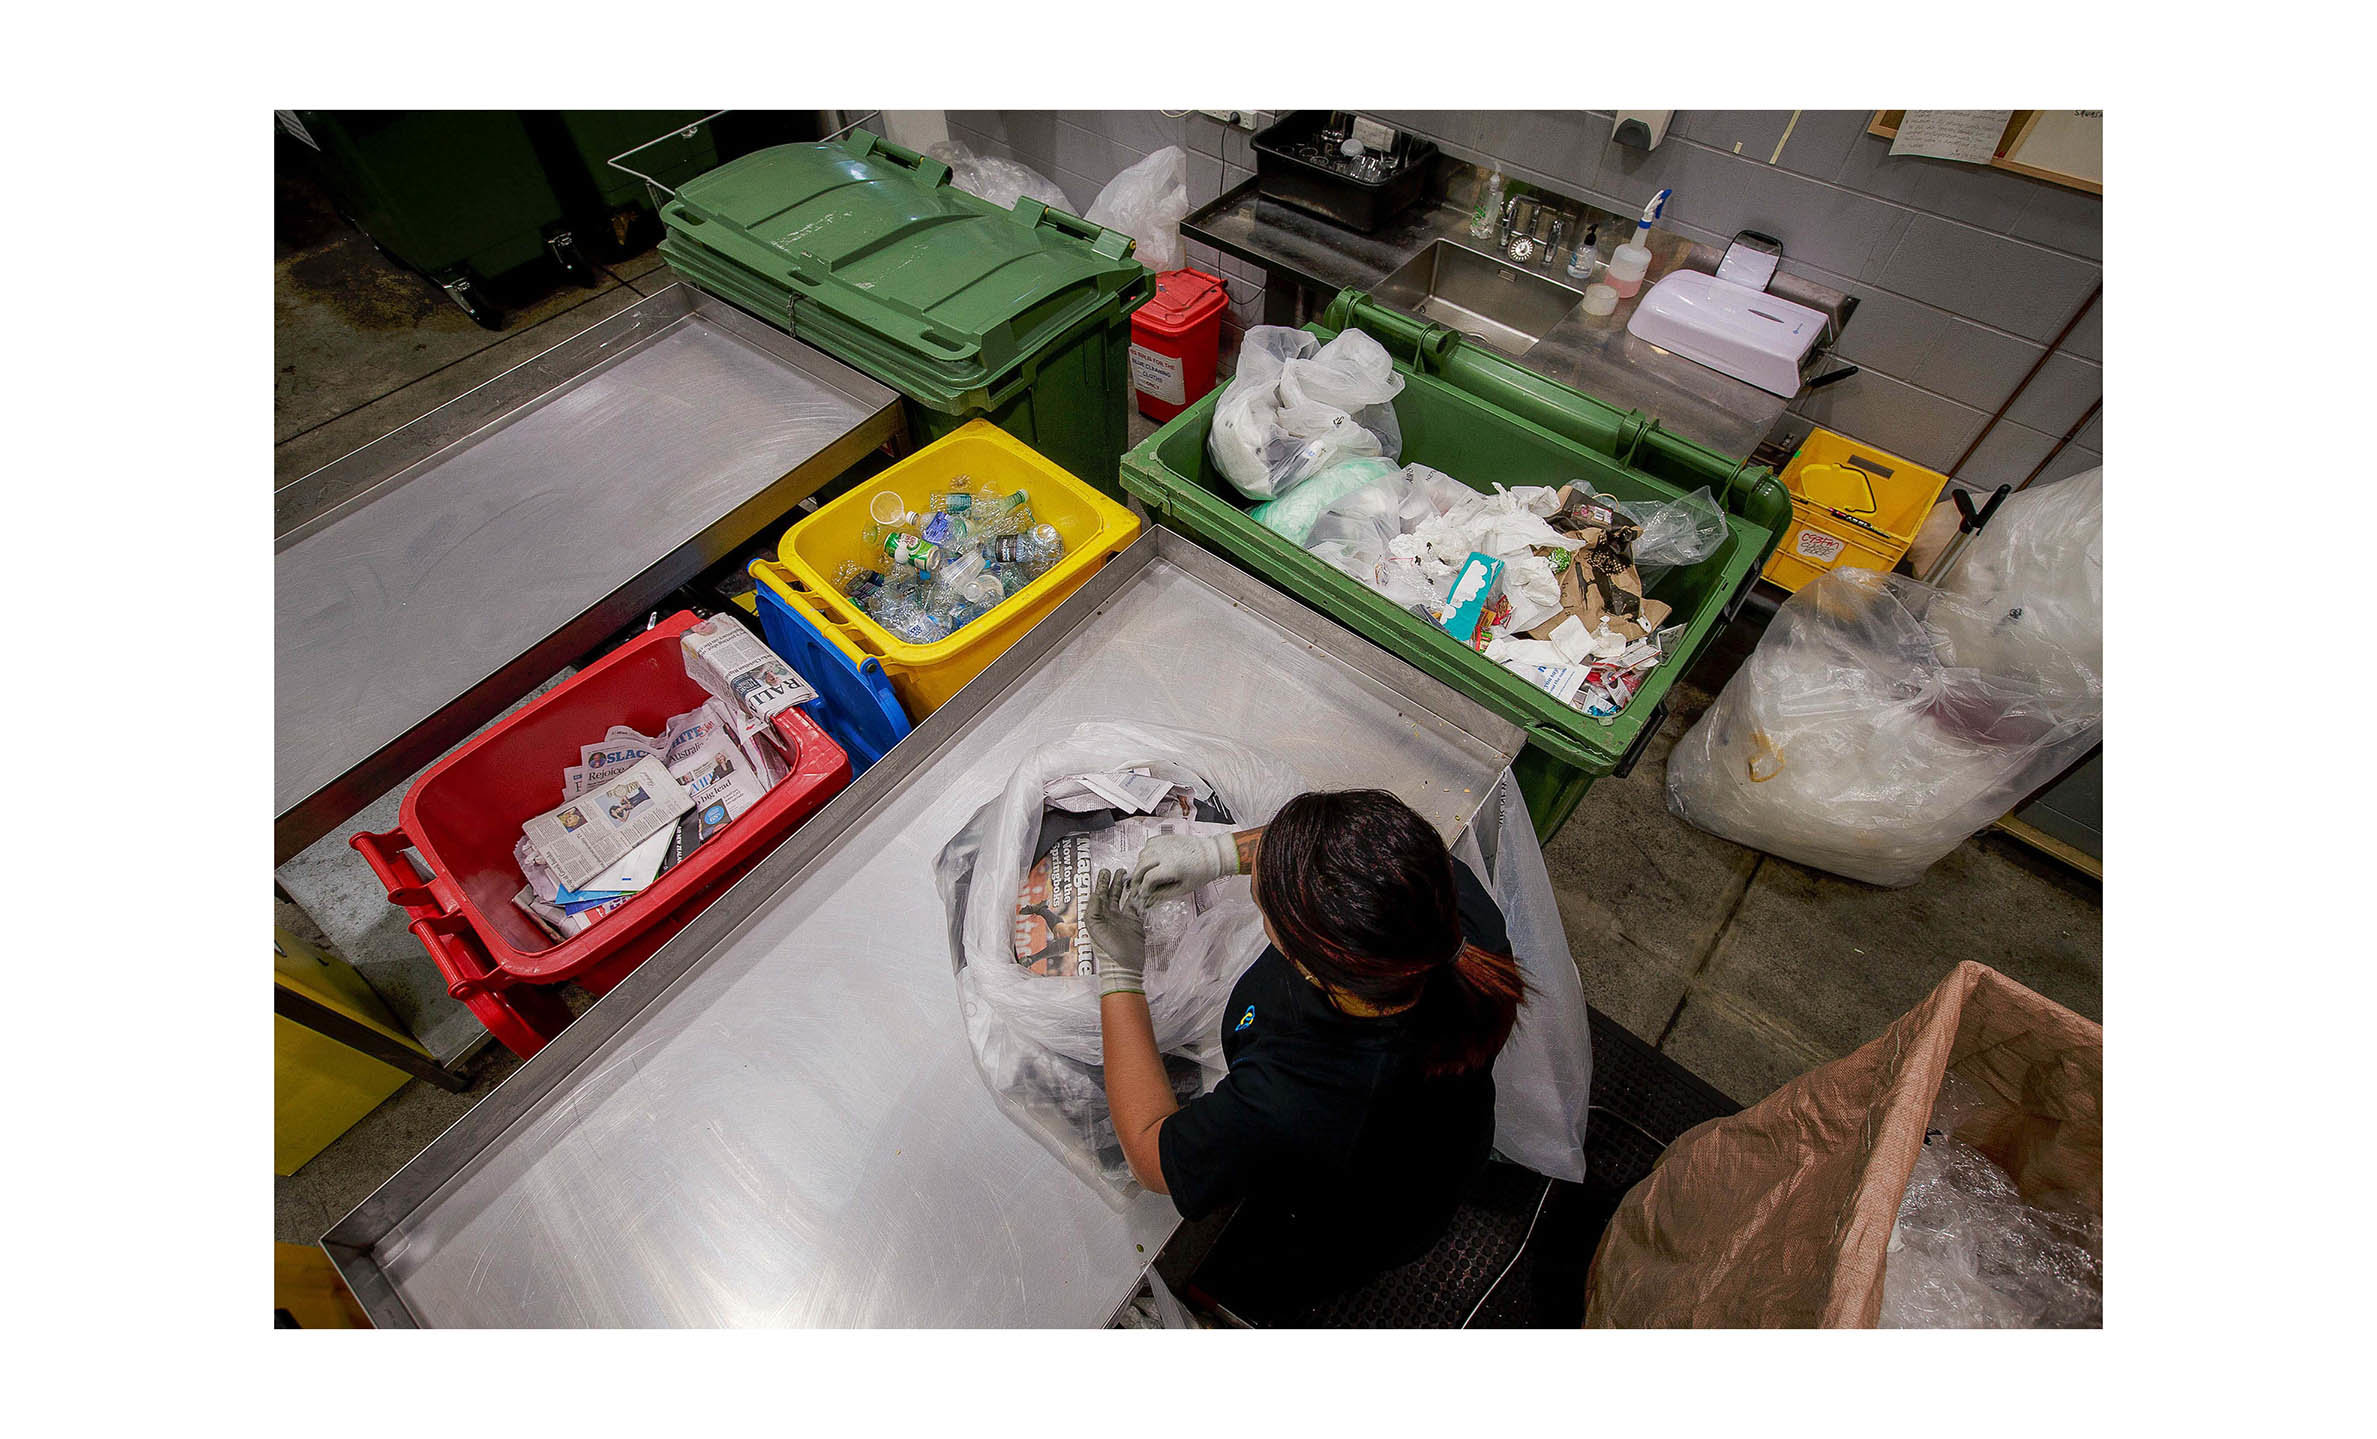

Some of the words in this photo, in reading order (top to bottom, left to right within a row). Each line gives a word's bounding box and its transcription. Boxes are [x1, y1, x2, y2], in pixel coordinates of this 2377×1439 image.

[1145, 364, 1172, 378] CLEANING
[714, 779, 732, 795] lead
[1062, 838, 1073, 864] Now
[1050, 842, 1062, 908] Springboks
[1062, 865, 1073, 883] for
[1062, 884, 1073, 903] the
